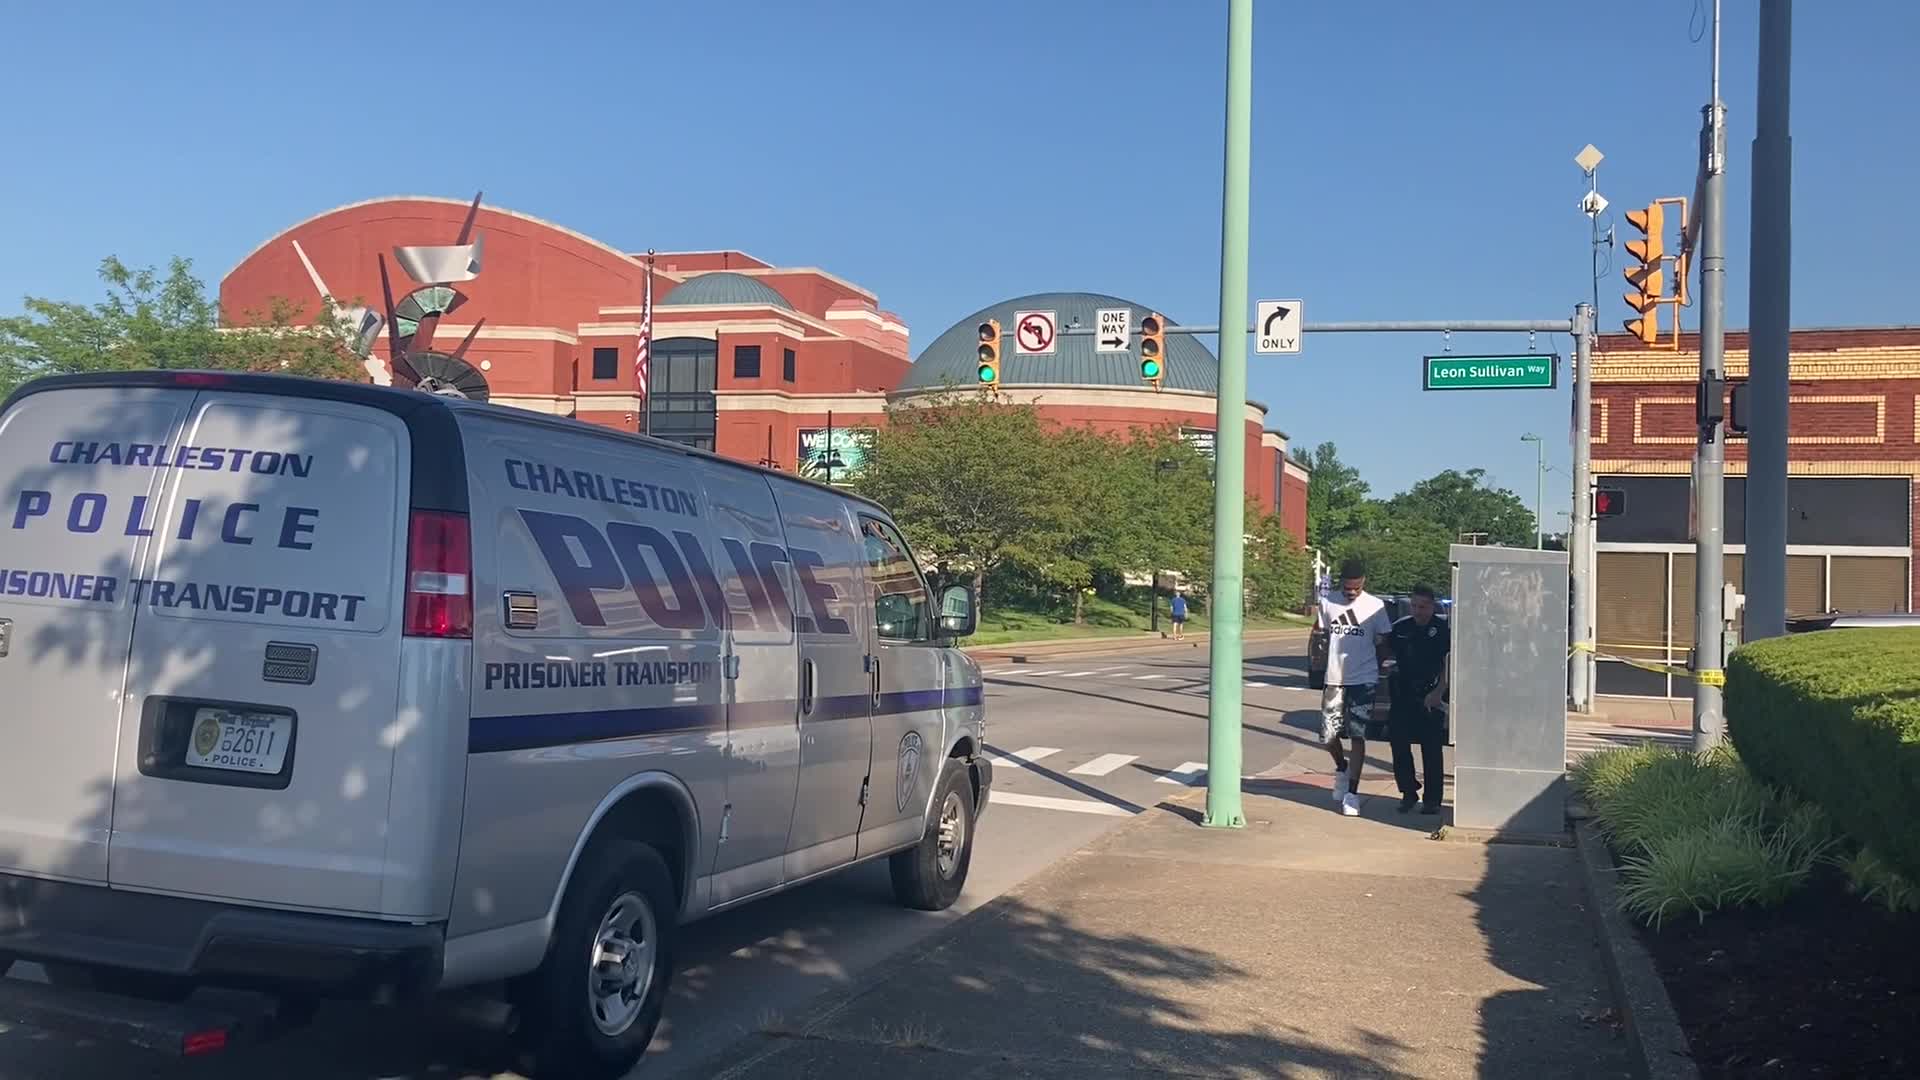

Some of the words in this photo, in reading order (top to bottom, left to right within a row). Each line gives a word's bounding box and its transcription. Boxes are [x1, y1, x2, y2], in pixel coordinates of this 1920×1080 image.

[1101, 324, 1126, 334] WAY
[1102, 312, 1126, 323] ONE
[1262, 338, 1295, 349] ONLY
[1433, 366, 1466, 379] Leon
[1469, 364, 1524, 378] Sullivan
[1527, 364, 1546, 375] Way
[49, 441, 314, 478] CHARLESTON
[504, 458, 699, 517] CHARLESTON
[12, 490, 320, 551] POLICE
[516, 507, 852, 636] POLICE
[130, 578, 366, 623] TRANSPORT
[484, 662, 607, 691] PRISONER
[613, 661, 722, 687] TRANSPOR
[212, 754, 257, 768] POLICE
